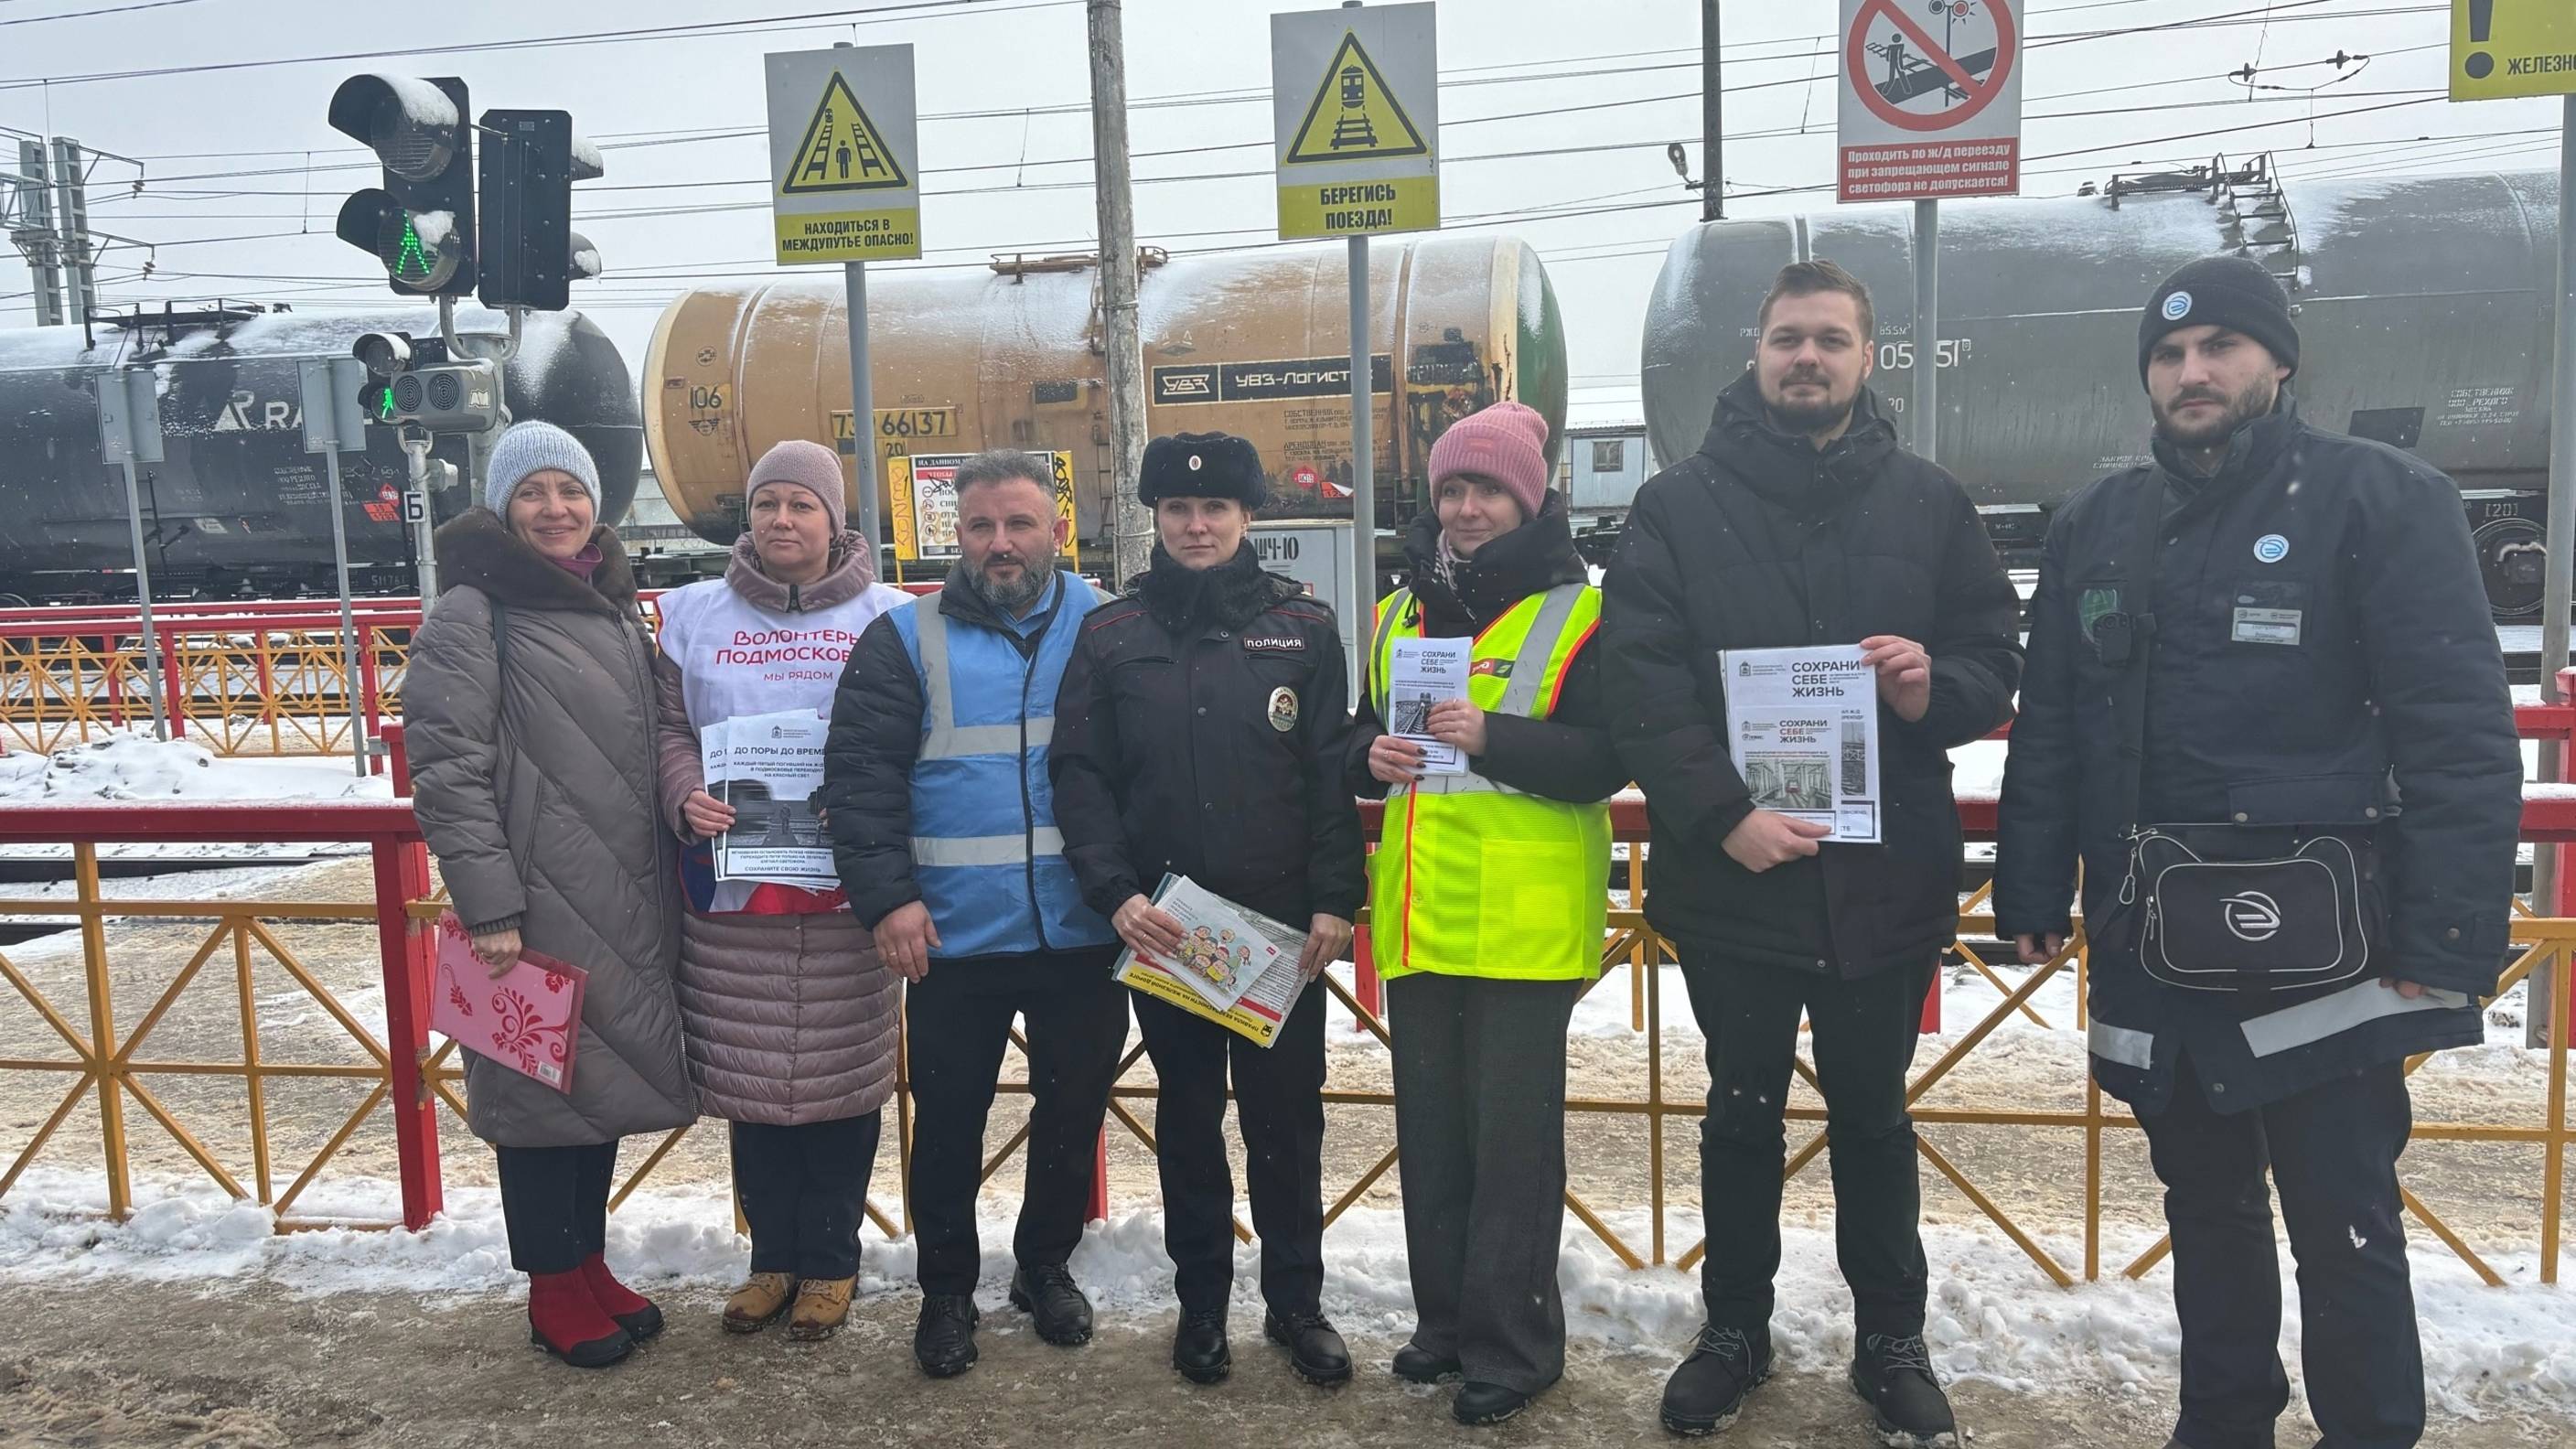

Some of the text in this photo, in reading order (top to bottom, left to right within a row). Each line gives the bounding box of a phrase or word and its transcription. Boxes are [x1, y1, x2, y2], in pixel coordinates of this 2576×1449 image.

[1848, 144, 2011, 164] Проходить по ж/д переезду
[1848, 160, 2010, 179] при запрещающем сигнале
[1848, 176, 2009, 195] светофора не допускается!
[1320, 184, 1396, 205] БЕРЕГИСЬ
[805, 219, 890, 235] НАХОДИТЬСЯ В
[1326, 209, 1392, 230] ПОЕЗДА!
[782, 232, 914, 252] МЕЖДУПУТЬЕ ОПАСНО!
[1236, 370, 1373, 387] УВЗ-ЛОГИСТ
[690, 385, 722, 409] 106
[833, 411, 946, 437] 7366137
[405, 493, 424, 520] Б
[1422, 650, 1456, 659] СОХРАНИ
[1420, 666, 1446, 674] ЖИЗНЬ
[1791, 660, 1860, 673] СОХРАНИ
[764, 671, 833, 682] МЫ РЯДОМ
[1791, 674, 1827, 685] СЕБЕ
[1792, 686, 1844, 698] ЖИЗНЬ
[1779, 735, 1817, 744] ЖИЗНЬ
[735, 746, 748, 755] ДО
[751, 746, 778, 755] ПОРЫ
[780, 747, 795, 756] ДО
